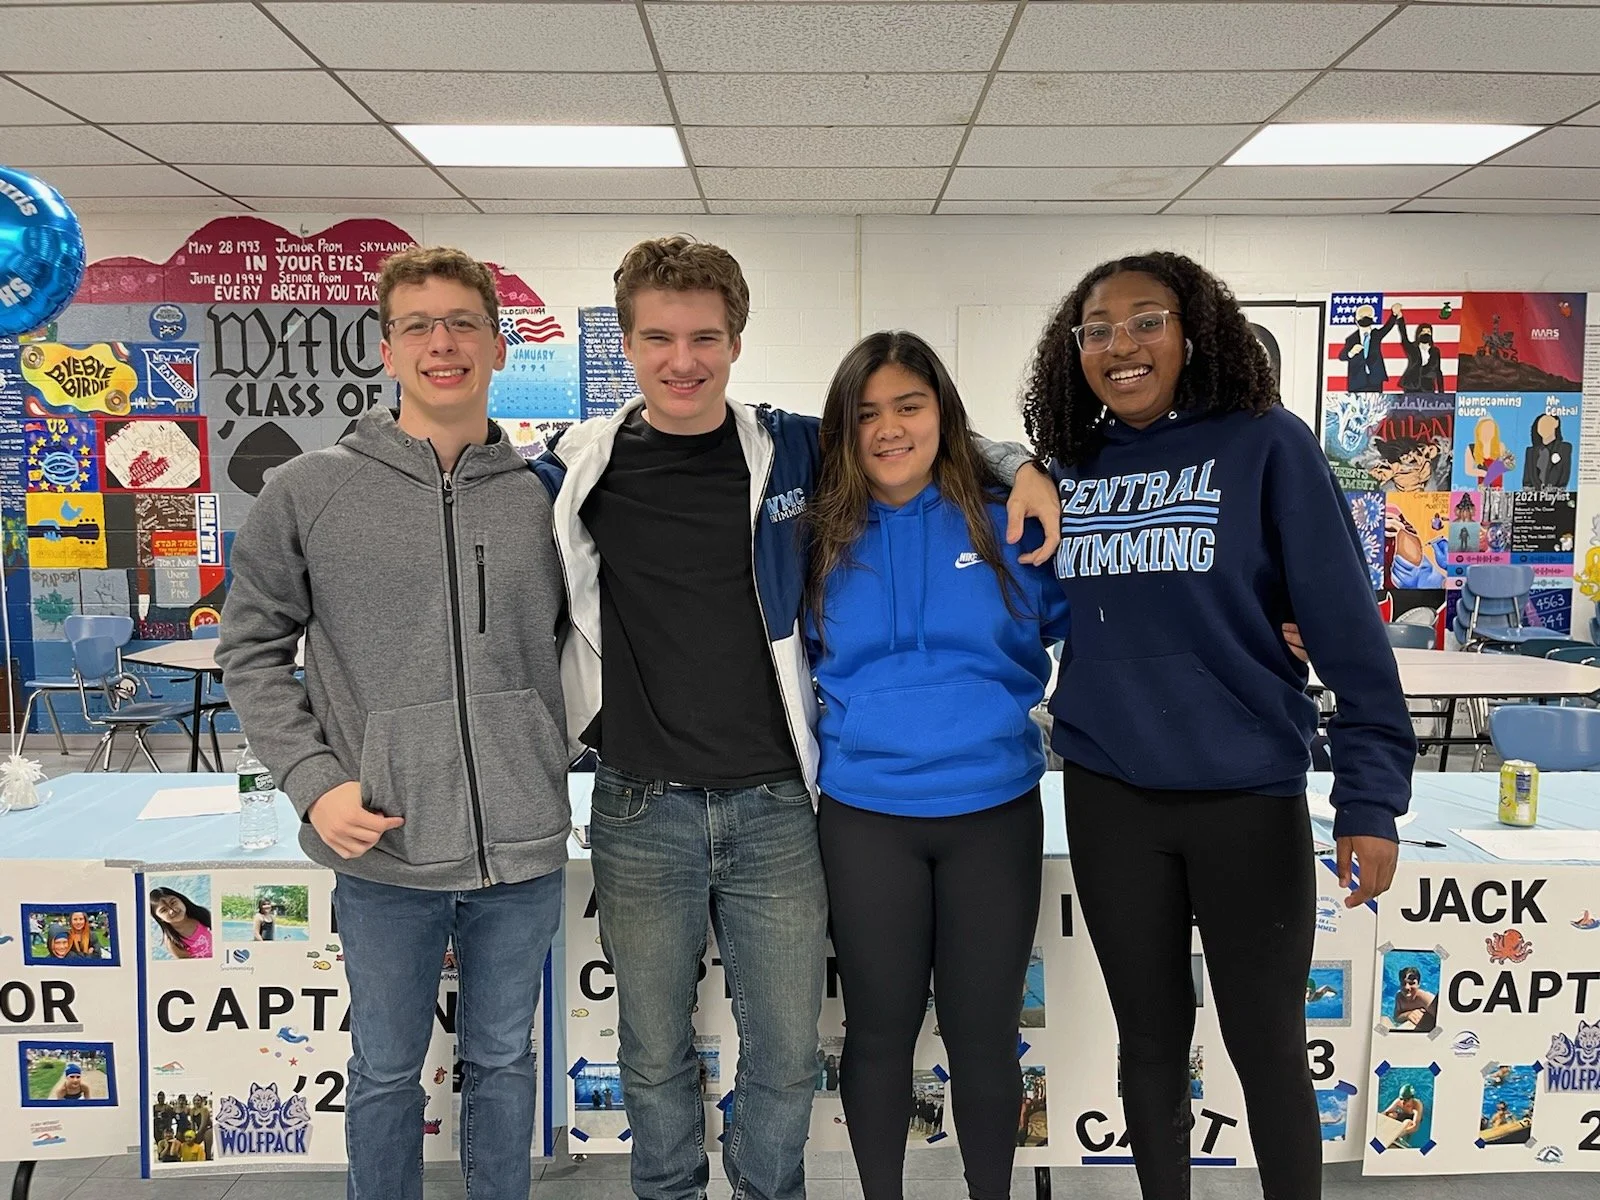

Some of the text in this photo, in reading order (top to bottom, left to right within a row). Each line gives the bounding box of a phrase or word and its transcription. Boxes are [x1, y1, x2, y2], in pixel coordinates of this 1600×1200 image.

[219, 241, 232, 254] 28
[237, 241, 260, 252] 1993
[246, 255, 363, 271] IN YOUR EYES
[219, 274, 231, 285] 10
[236, 274, 262, 284] 1994
[214, 285, 379, 300] EVERY BREATH YOU TAK
[1531, 328, 1560, 337] MARS
[152, 354, 171, 363] NEW
[513, 348, 555, 360] JANUARY
[158, 363, 195, 399] RANGERS
[226, 383, 382, 416] CLASS OF
[1458, 396, 1522, 407] Homecoming
[1546, 395, 1560, 406] Mr
[1545, 405, 1578, 416] Central
[1515, 490, 1571, 506] 2021 Playlist
[199, 496, 216, 563] HELMET
[960, 552, 978, 562] NIKE
[1054, 527, 1216, 579] WIMMING
[1535, 594, 1565, 611] 4563
[1400, 877, 1548, 924] JACK
[218, 1126, 307, 1156] WOLFPACK
